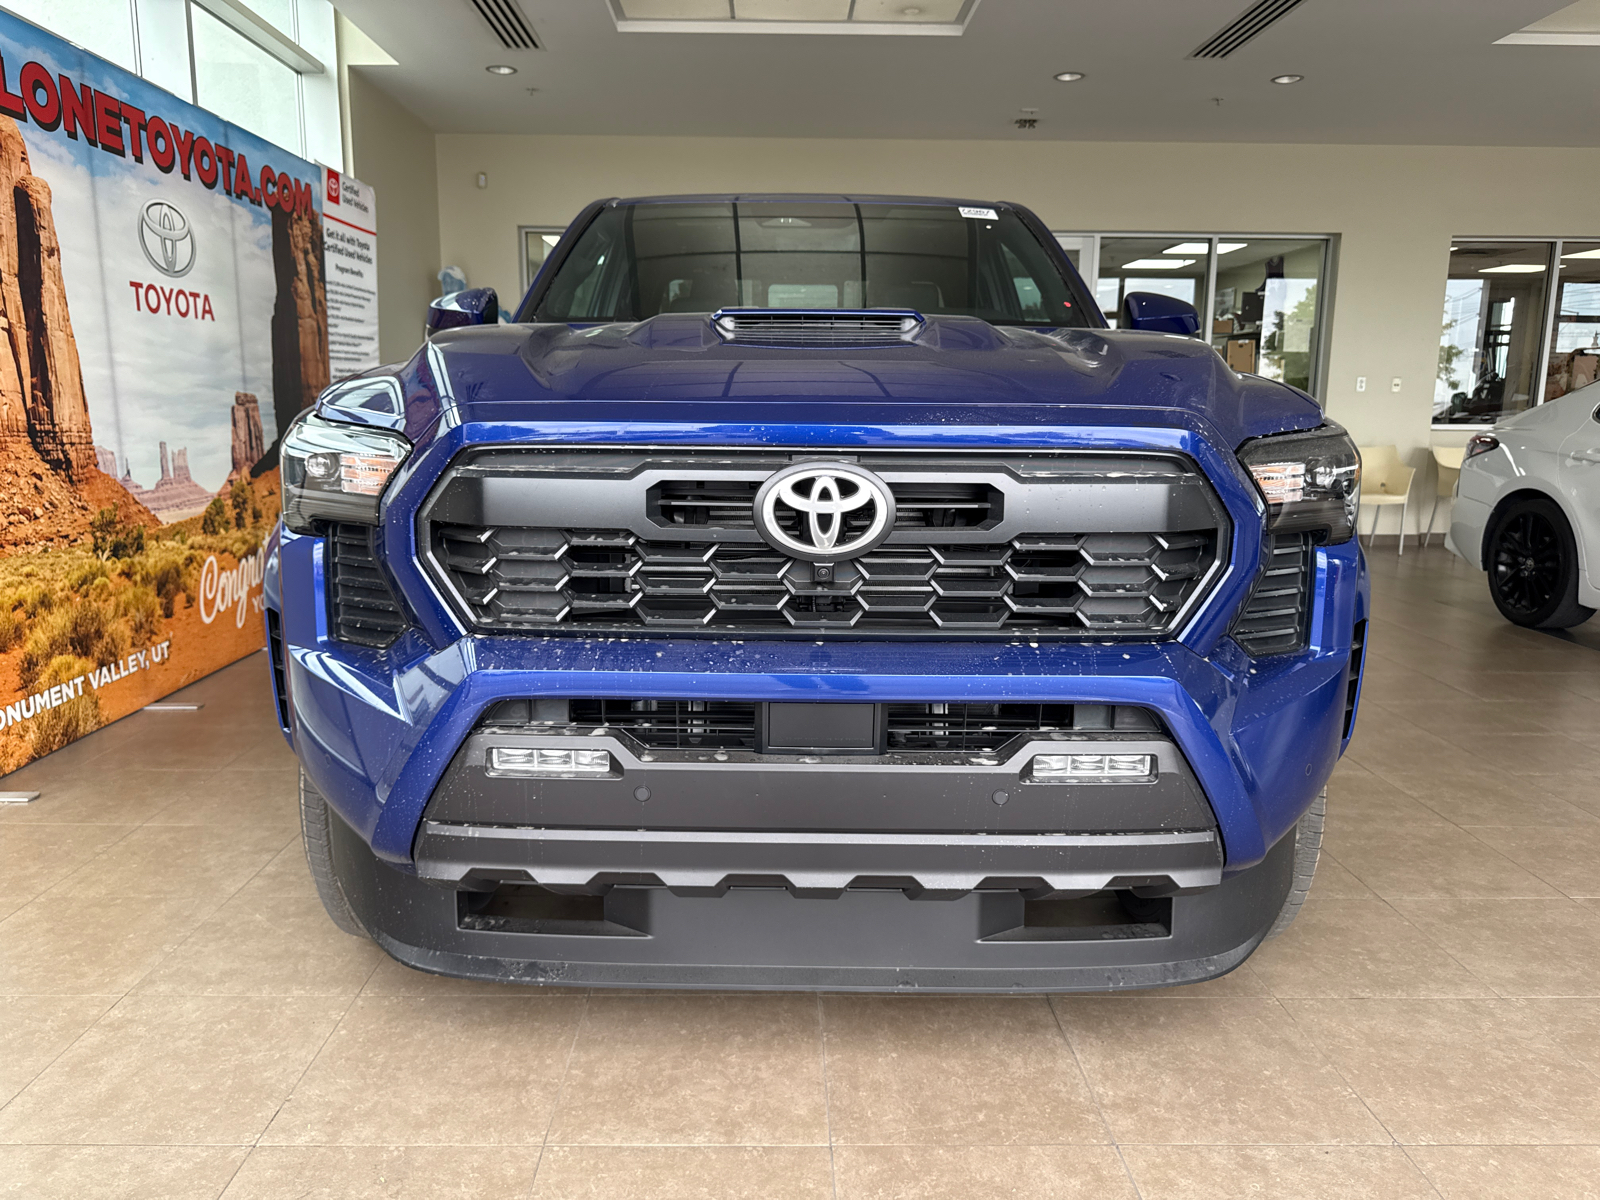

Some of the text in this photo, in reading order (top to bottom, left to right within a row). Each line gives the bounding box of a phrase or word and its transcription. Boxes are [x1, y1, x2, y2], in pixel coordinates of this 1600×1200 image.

[342, 181, 359, 198] Certified
[342, 195, 369, 213] Used Vehicles
[326, 228, 335, 239] Get
[346, 234, 356, 245] with
[356, 238, 370, 251] Toyota
[324, 241, 373, 265] Certified Used Vehicles
[129, 281, 215, 322] TOYOTA
[88, 650, 150, 690] VALLEY,
[151, 641, 170, 663] UT
